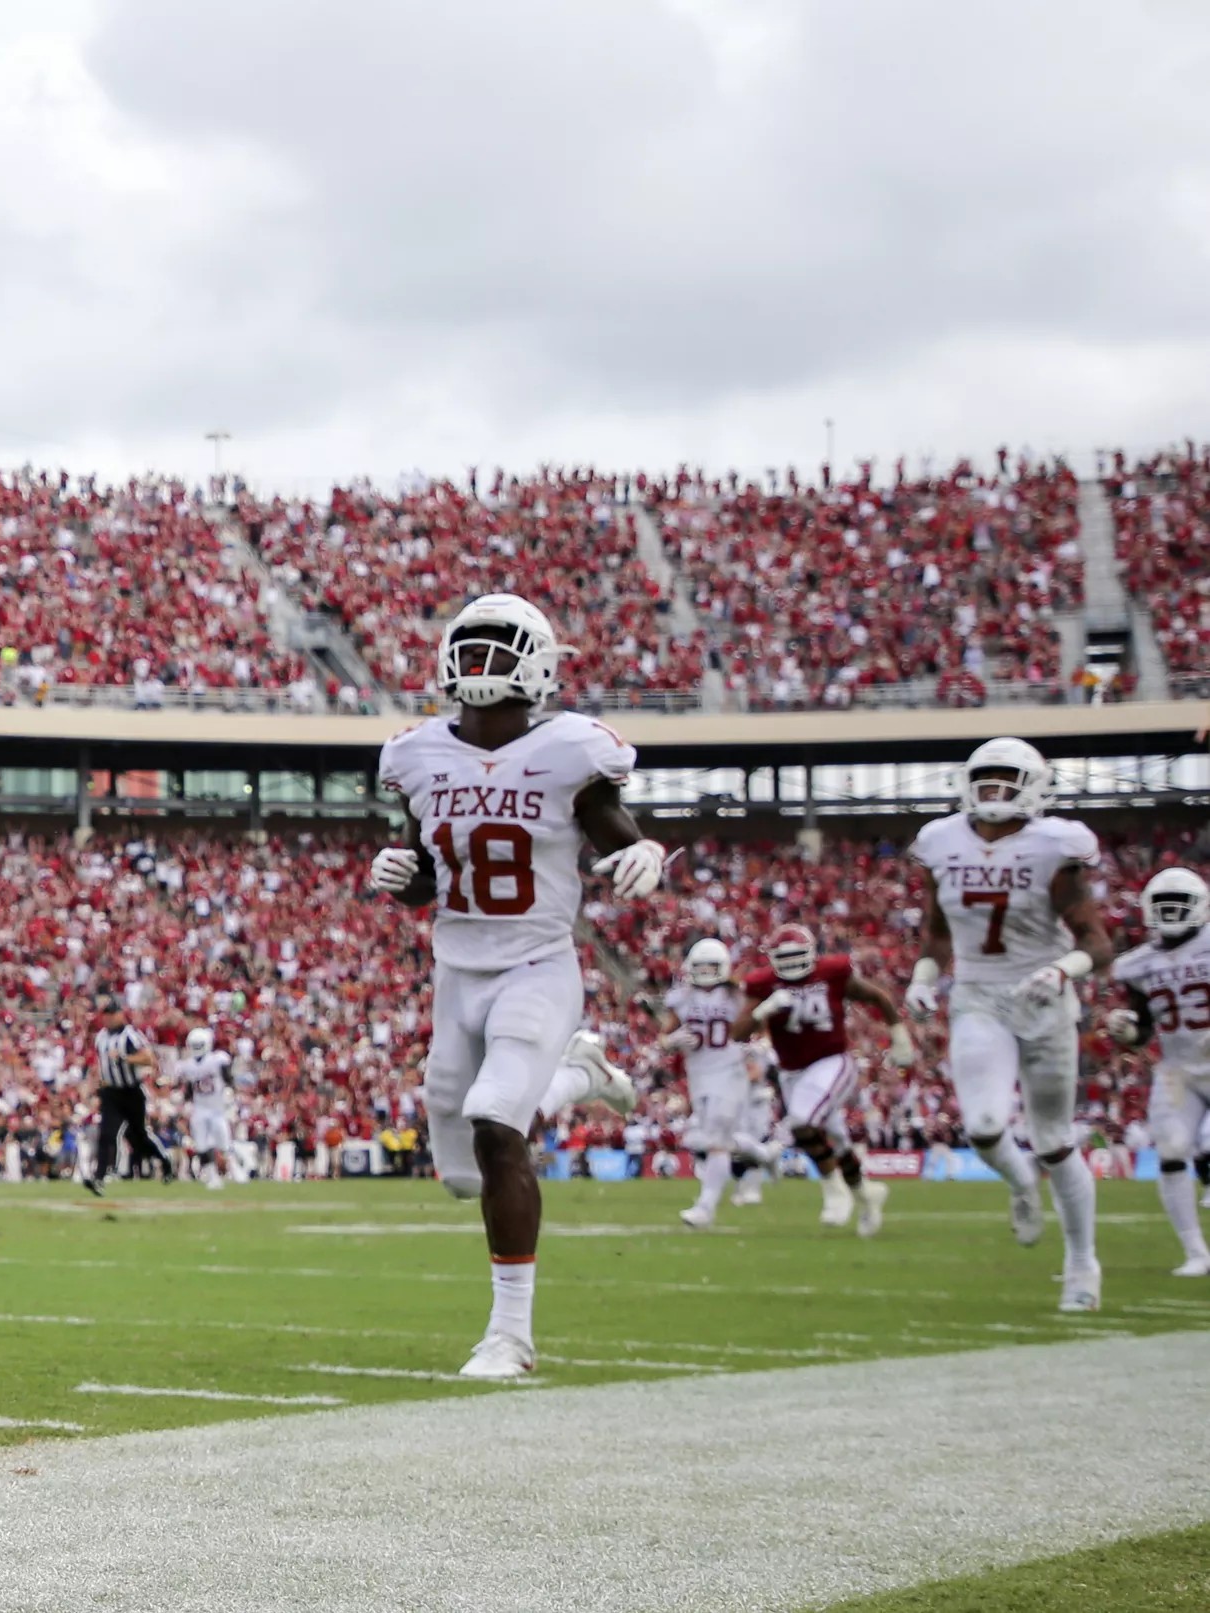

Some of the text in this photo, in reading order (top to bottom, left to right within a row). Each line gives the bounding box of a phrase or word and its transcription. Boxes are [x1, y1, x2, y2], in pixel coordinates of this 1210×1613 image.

[431, 786, 544, 819] TEXAS
[431, 822, 535, 915] 18
[947, 866, 1033, 890] TEXAS
[962, 891, 1009, 955] 7
